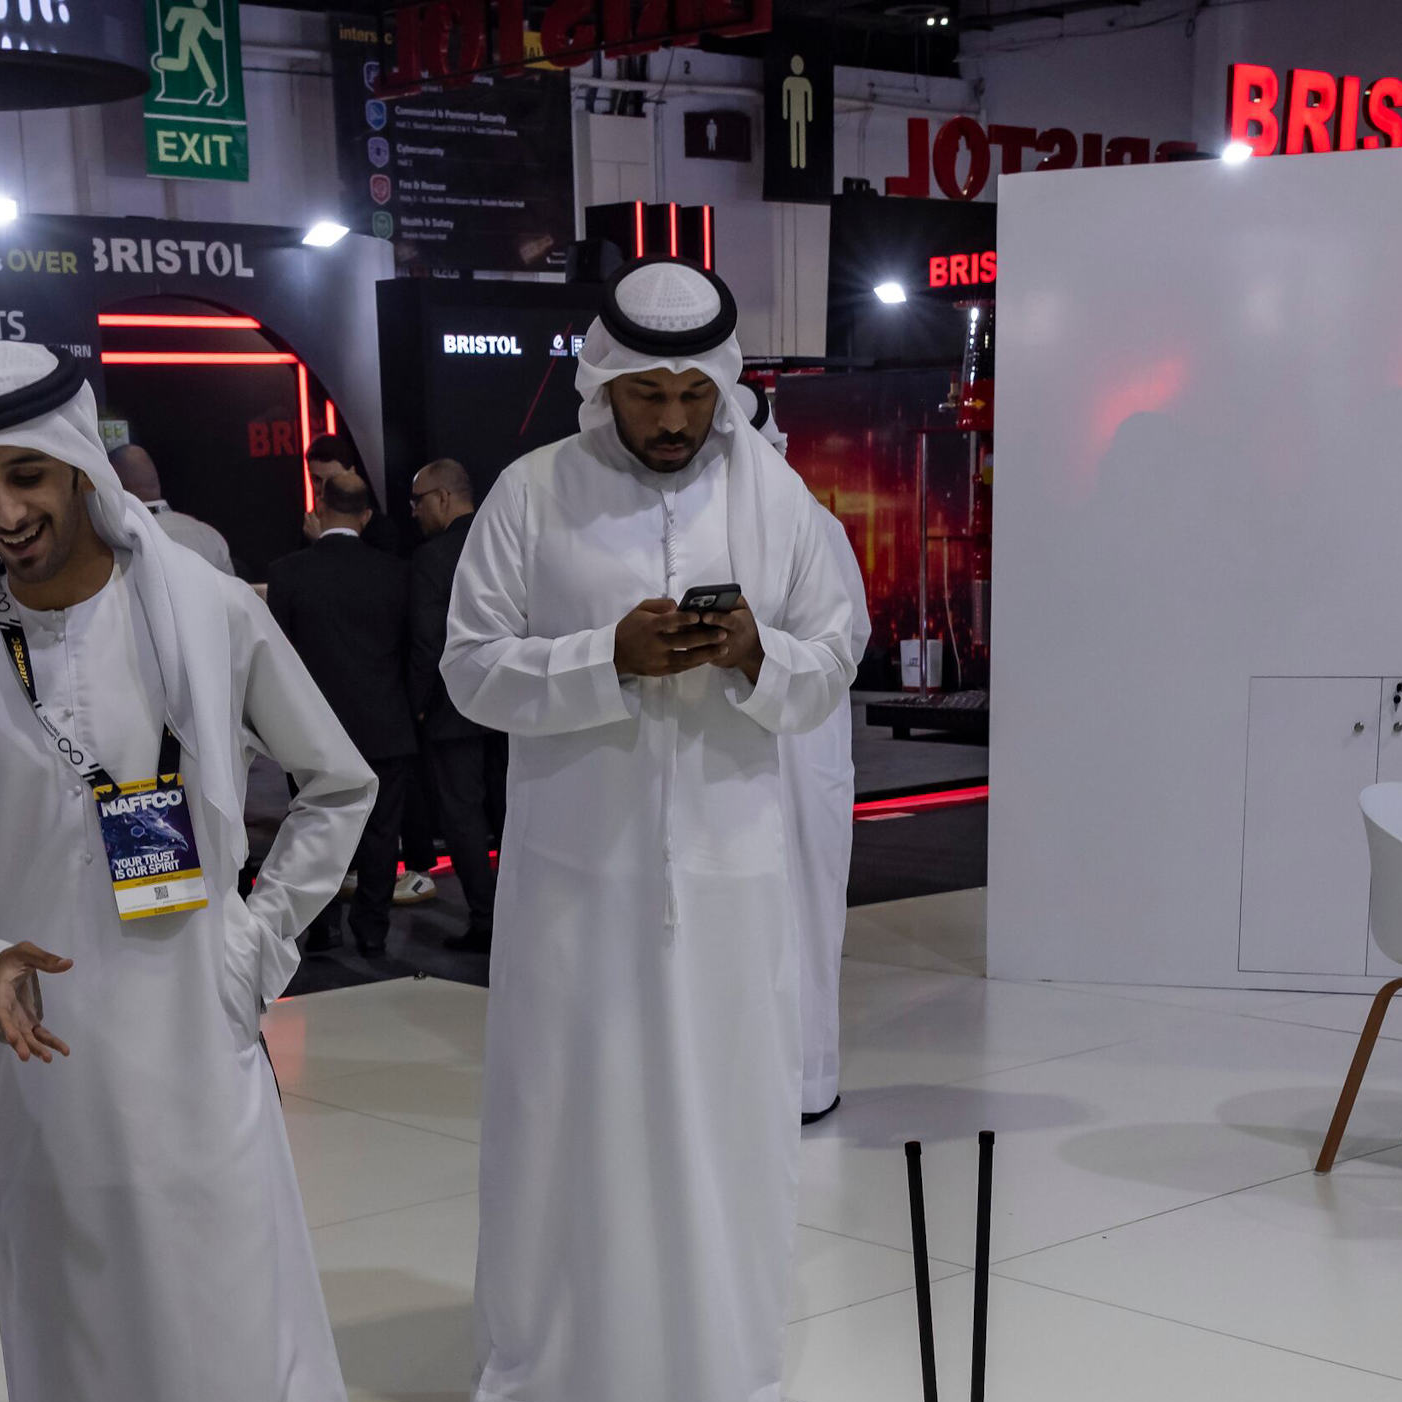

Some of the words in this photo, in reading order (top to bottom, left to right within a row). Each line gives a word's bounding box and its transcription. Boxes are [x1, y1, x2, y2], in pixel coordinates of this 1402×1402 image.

[339, 24, 394, 45] intersc
[156, 130, 233, 166] EXIT
[6, 248, 79, 274] OVER
[92, 237, 254, 278] BRISTOL
[928, 250, 997, 288] BRIS
[443, 334, 522, 355] BRISTOL
[101, 789, 183, 818] NAFFCO
[114, 856, 143, 869] YOUR
[143, 850, 175, 864] TRUST
[115, 868, 126, 880] IS
[126, 865, 149, 877] OUR
[149, 859, 180, 873] SPIRIT
